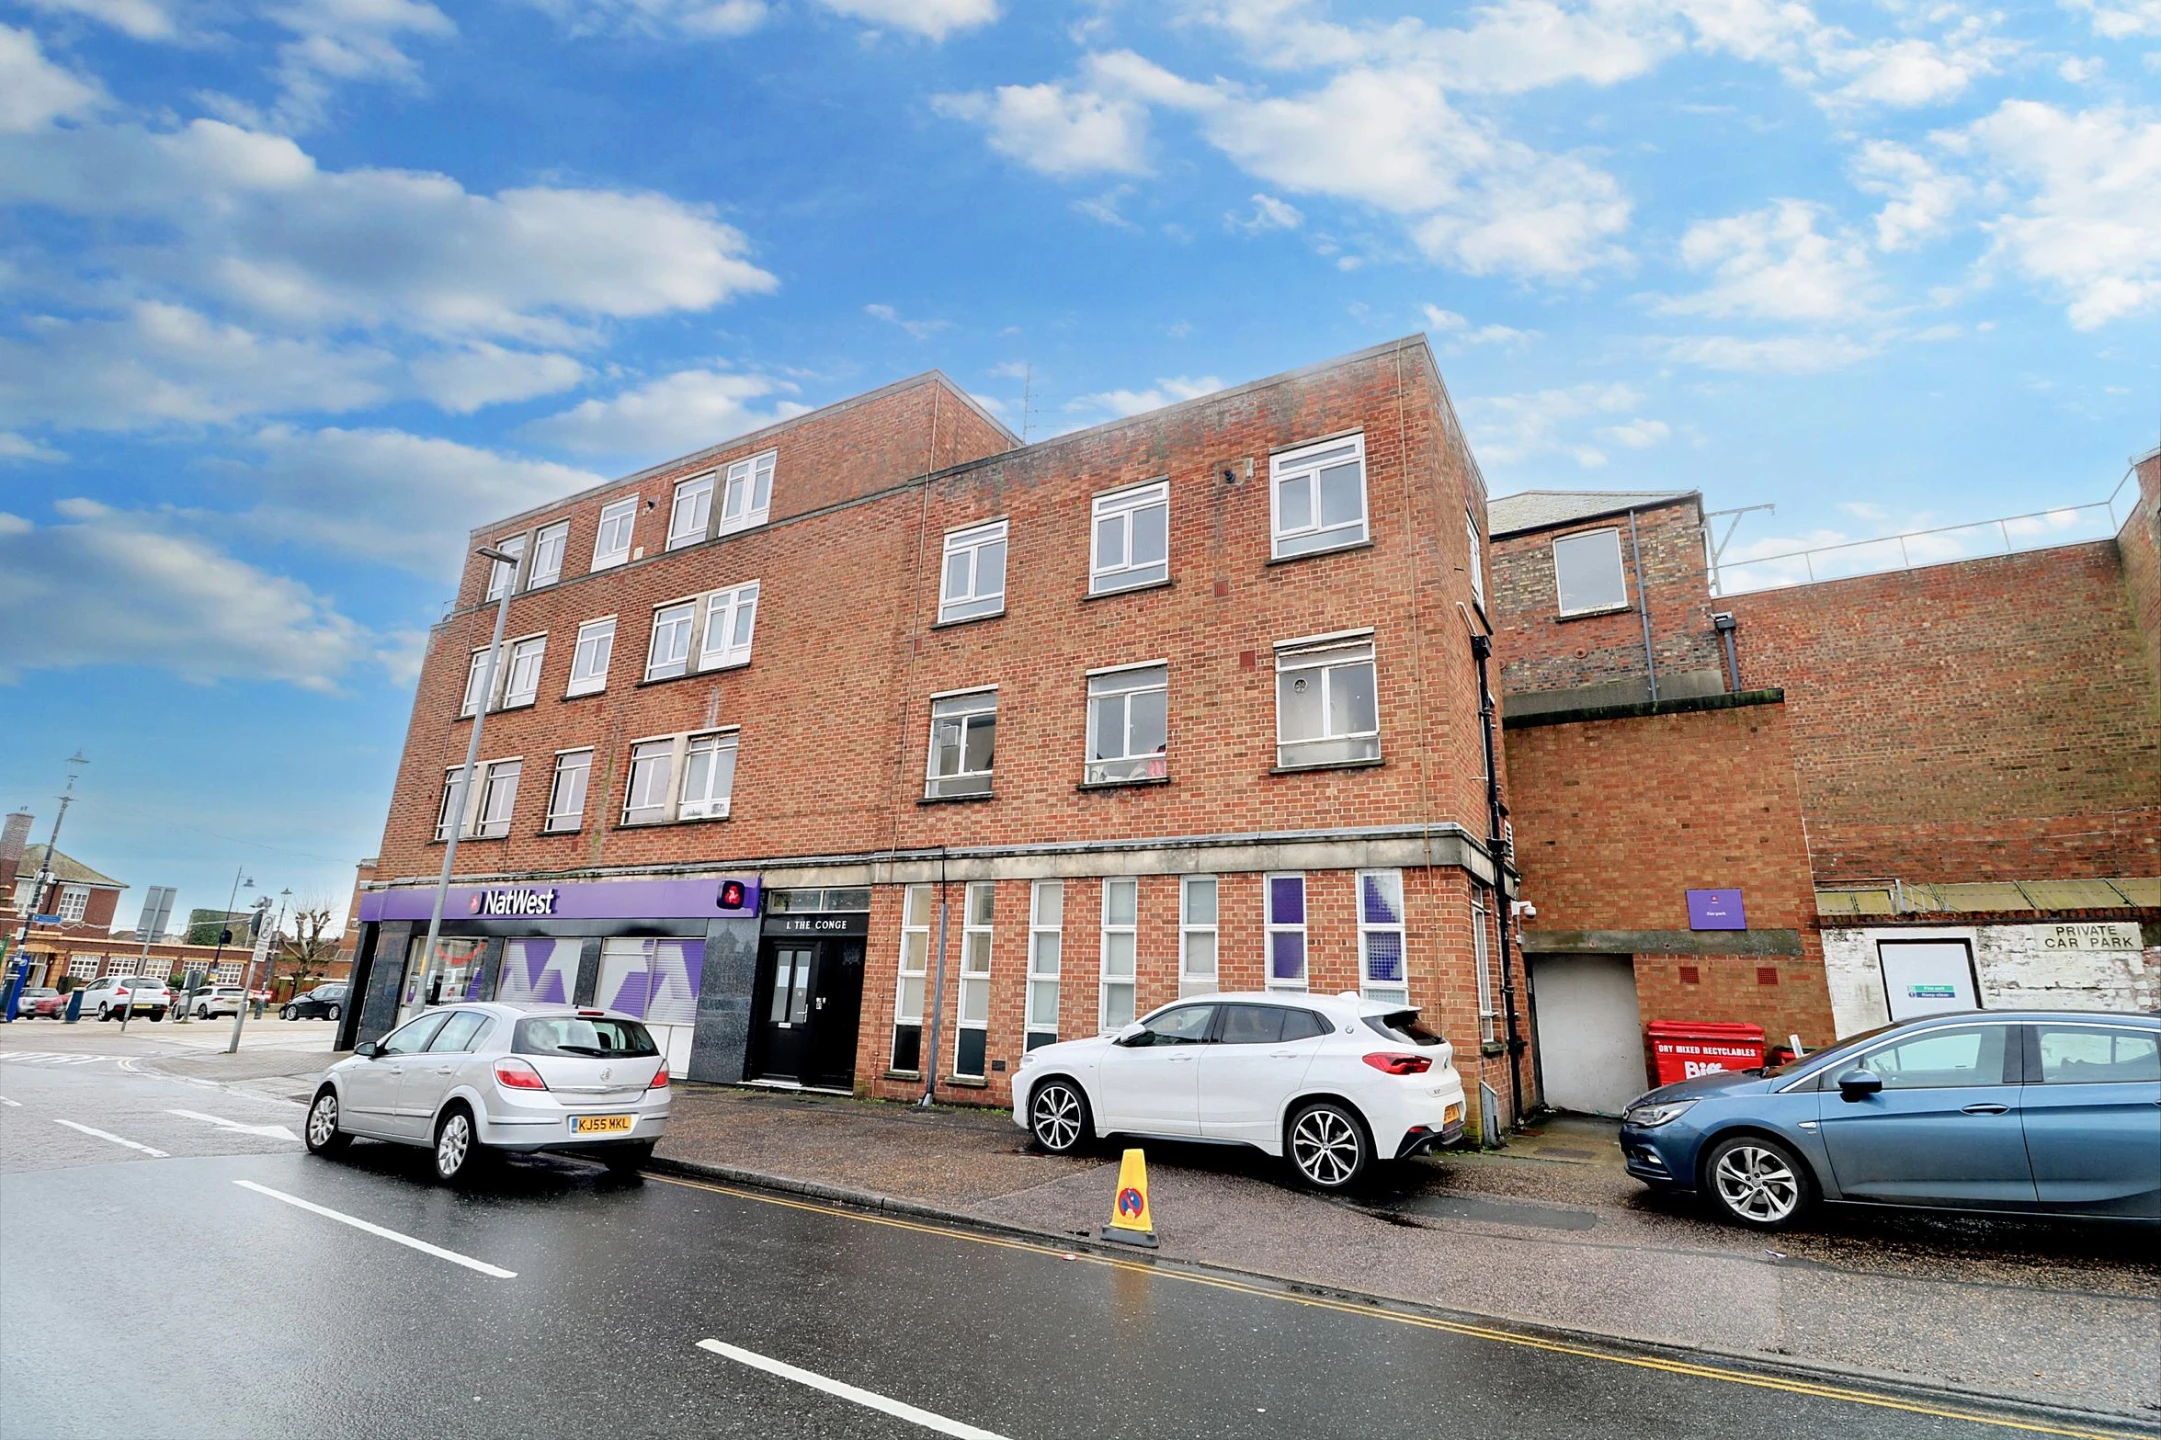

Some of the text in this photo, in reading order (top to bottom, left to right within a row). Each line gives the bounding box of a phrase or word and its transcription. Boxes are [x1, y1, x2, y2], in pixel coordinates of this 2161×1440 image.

[483, 888, 554, 915] NatWest
[794, 920, 811, 930] THE
[814, 920, 847, 930] CONGE
[2056, 926, 2117, 936] PRIVATE
[2045, 937, 2133, 948] CAR PARK
[1659, 1045, 1756, 1057] DRY MIXED RECYCLABLES
[1684, 1061, 1729, 1079] Biff
[578, 1118, 629, 1131] KJ55 MKL
